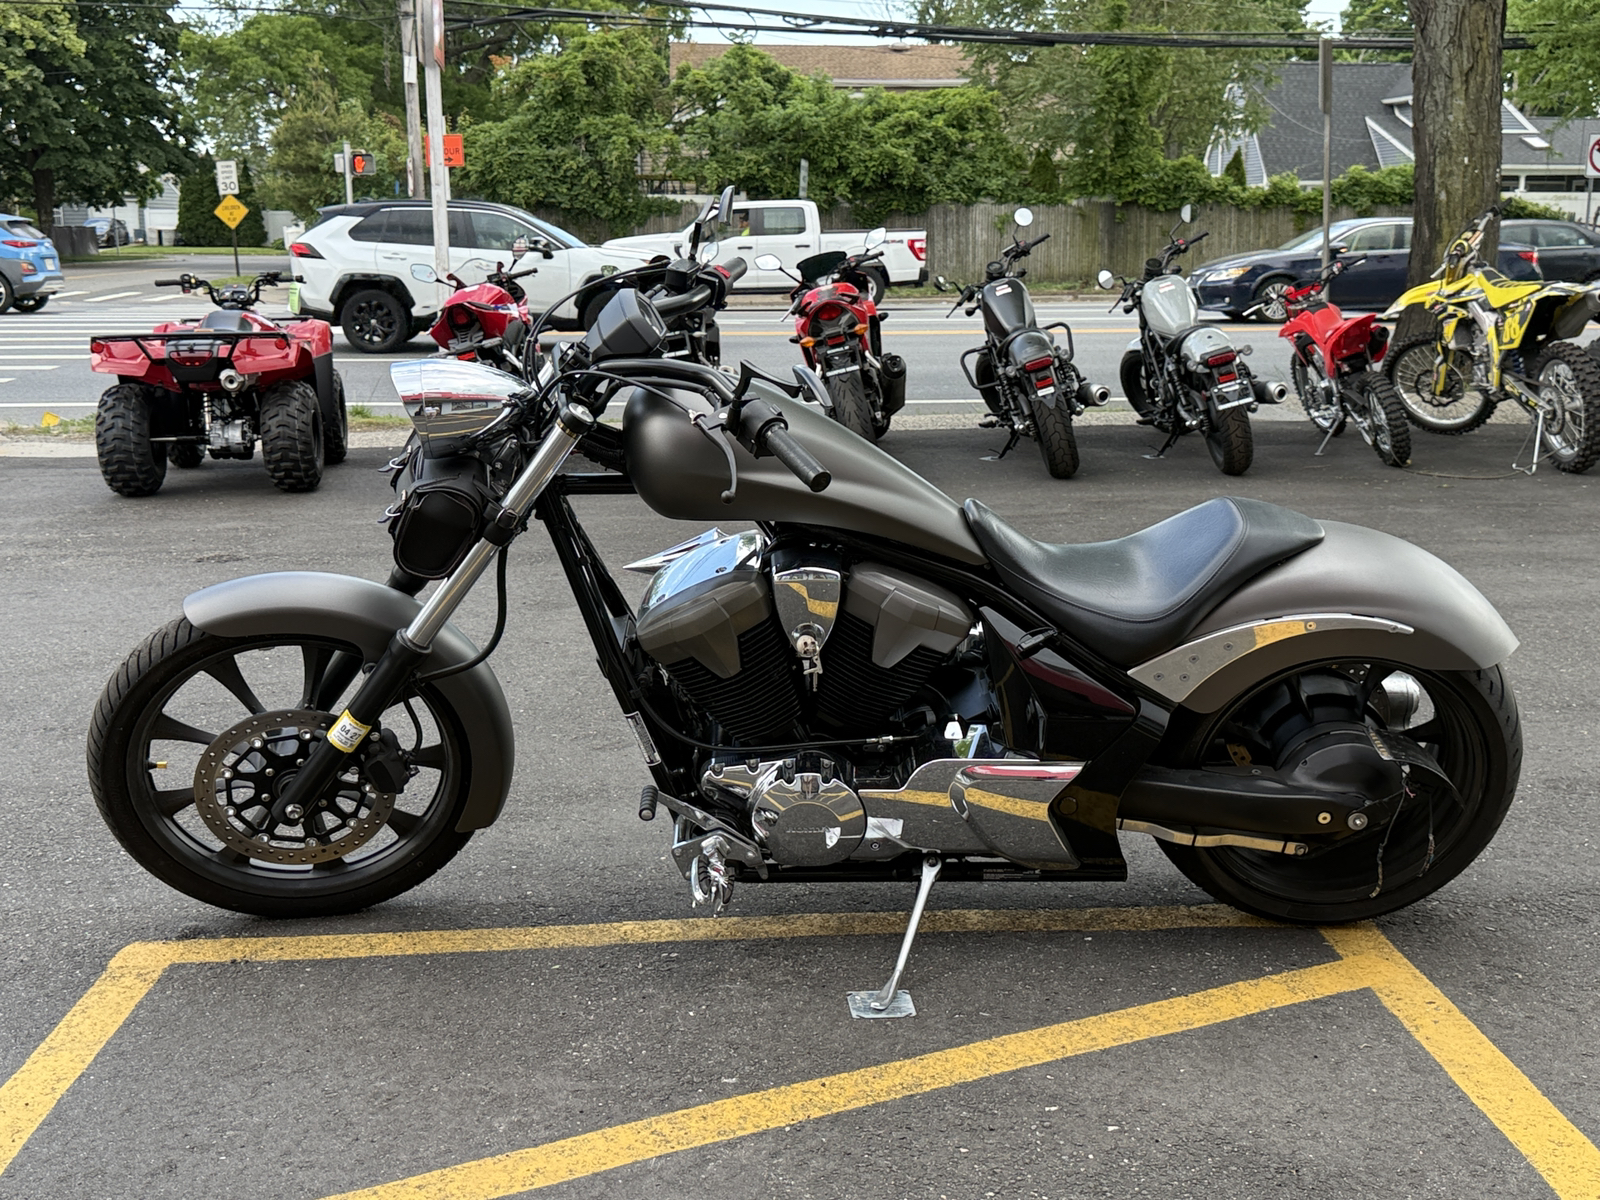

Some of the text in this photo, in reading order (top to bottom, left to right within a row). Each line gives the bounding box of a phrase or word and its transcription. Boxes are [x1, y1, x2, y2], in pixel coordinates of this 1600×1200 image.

[221, 181, 236, 191] 30
[340, 724, 351, 736] 04
[785, 826, 830, 834] HONDA
